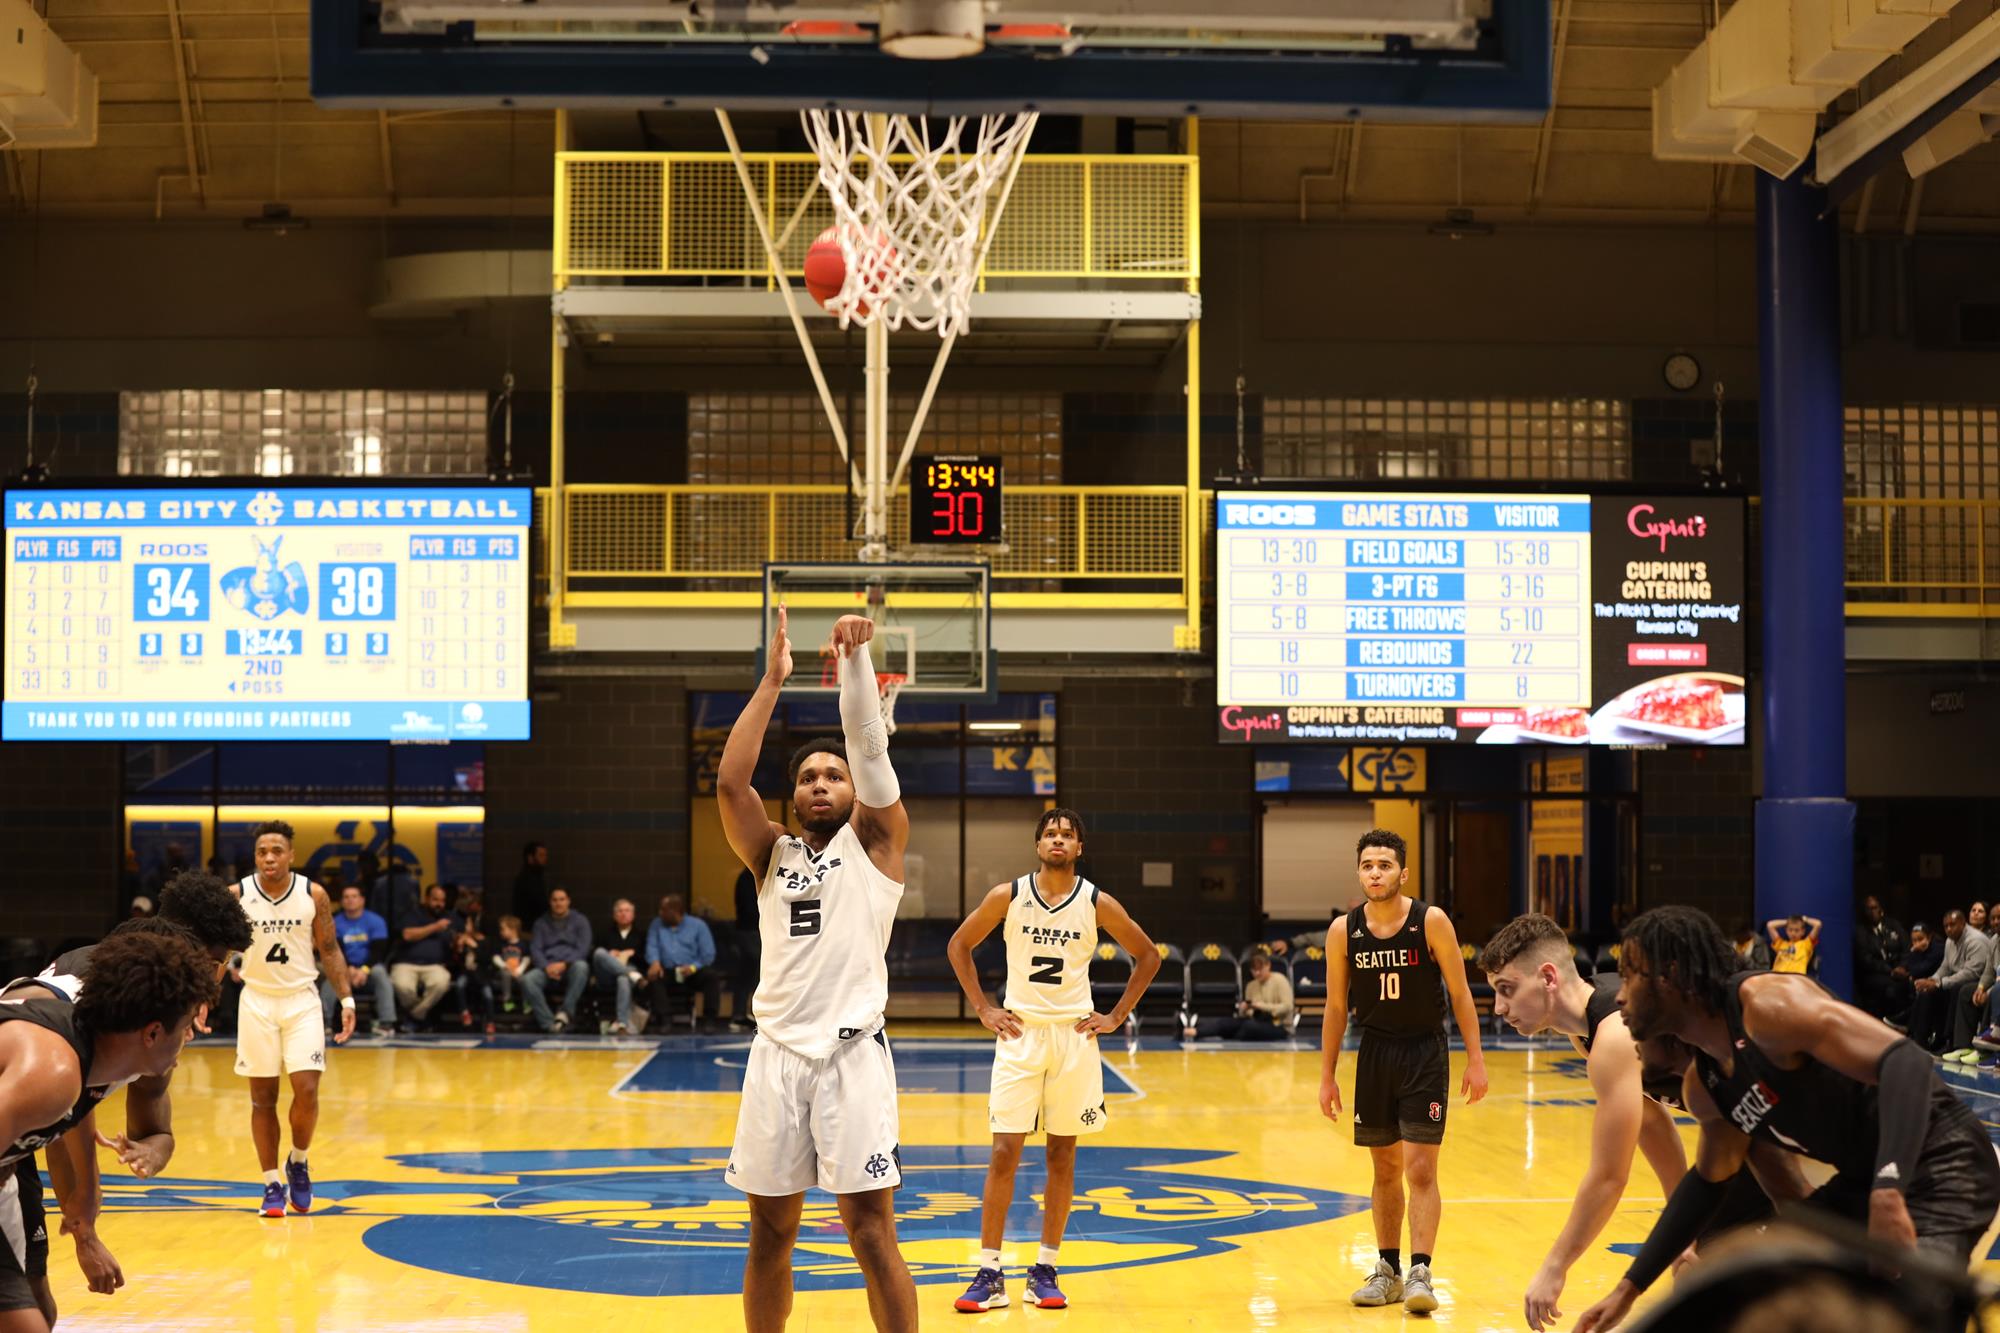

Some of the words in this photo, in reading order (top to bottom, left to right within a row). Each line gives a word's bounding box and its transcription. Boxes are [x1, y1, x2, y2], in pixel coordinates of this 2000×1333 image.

[928, 463, 995, 489] 13:44
[15, 501, 146, 520] KANSAS
[159, 501, 237, 519] CITY
[293, 499, 518, 518] BASKETBALL
[932, 492, 983, 536] 30
[1225, 504, 1317, 526] ROOS
[1341, 504, 1402, 527] GAME
[1404, 504, 1469, 528] STATS
[1494, 505, 1560, 528] VISITOR
[16, 540, 48, 558] PLYR
[57, 540, 79, 558] FLS
[92, 540, 116, 558] PTS
[140, 543, 208, 557] ROOS
[411, 538, 445, 556] PLYR
[453, 538, 477, 556] FLS
[488, 538, 514, 556] PTS
[1261, 539, 1317, 564] 13-30
[1352, 541, 1399, 565] FIELD
[1403, 541, 1457, 565] GOALS
[1494, 540, 1550, 566] 15-38
[63, 565, 72, 585] 0
[99, 565, 108, 584] 0
[460, 563, 470, 582] 3
[1626, 561, 1707, 581] CUPINI'S
[147, 567, 199, 617] 34
[331, 566, 383, 616] 38
[1271, 573, 1307, 598] 3-8
[1371, 575, 1414, 599] 3-PT
[1416, 575, 1438, 598] FG
[1500, 574, 1544, 599] 3-16
[1622, 580, 1711, 600] CATERING
[28, 591, 36, 611] 3
[63, 591, 72, 611] 2
[1594, 603, 1615, 617] The
[1678, 603, 1691, 618] Of
[62, 617, 71, 636] 0
[96, 617, 111, 636] 10
[1346, 606, 1388, 630] FREE
[1391, 606, 1466, 631] THROWS
[1636, 619, 1676, 634] Kansas
[1676, 619, 1698, 638] City
[1279, 640, 1298, 663] 18
[1360, 641, 1452, 665] REBOUNDS
[1511, 642, 1533, 665] 22
[244, 659, 283, 676] 2ND
[242, 681, 284, 694] POSS
[1279, 672, 1298, 697] 10
[1354, 673, 1456, 698] TURNOVERS
[1516, 675, 1527, 699] 8
[27, 711, 78, 728] THANK
[84, 711, 115, 728] YOU
[121, 711, 140, 728] TO
[146, 711, 177, 728] OUR
[184, 711, 263, 728] FOUNDING
[270, 711, 351, 728] PARTNERS
[1287, 707, 1359, 724] CUPINI'S
[1364, 707, 1444, 725] CATERING
[1288, 725, 1304, 737] The
[776, 858, 842, 885] KANAS
[786, 872, 825, 891] CIY
[790, 898, 822, 938] 5
[263, 926, 292, 934] CITY
[1022, 925, 1081, 941] KANSAS
[1032, 935, 1069, 947] CITY
[265, 943, 289, 965] 4
[1028, 955, 1064, 985] 2
[1379, 972, 1401, 1001] 10
